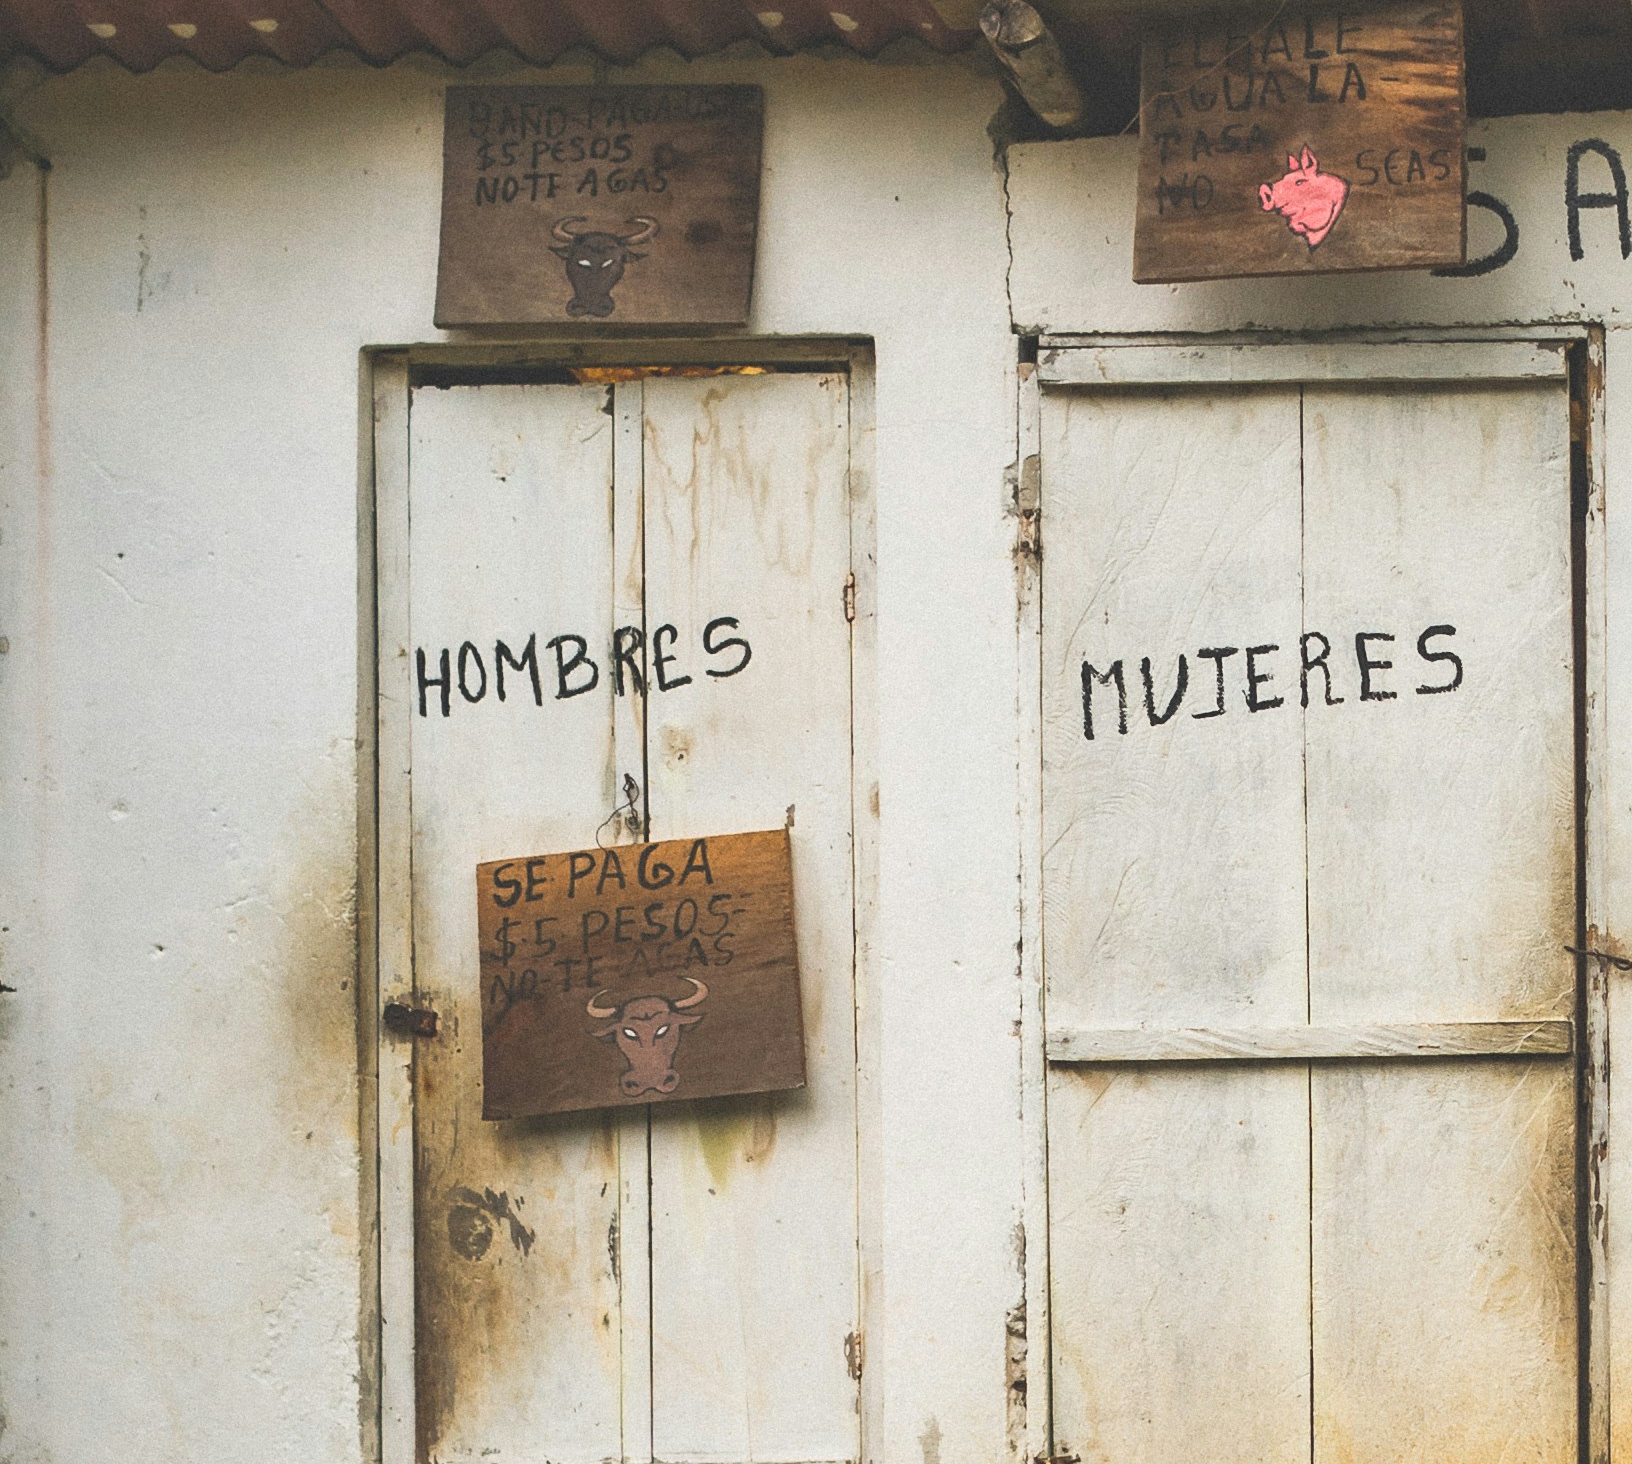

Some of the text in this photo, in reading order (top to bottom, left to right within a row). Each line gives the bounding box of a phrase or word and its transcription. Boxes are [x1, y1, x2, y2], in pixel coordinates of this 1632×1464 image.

[531, 134, 633, 169] PESOS
[1356, 148, 1451, 187] SEAS
[576, 167, 668, 197] AGAS
[415, 616, 752, 718] HOMBRES
[1081, 624, 1464, 741] MUJERES
[493, 838, 713, 908] SE PAGA
